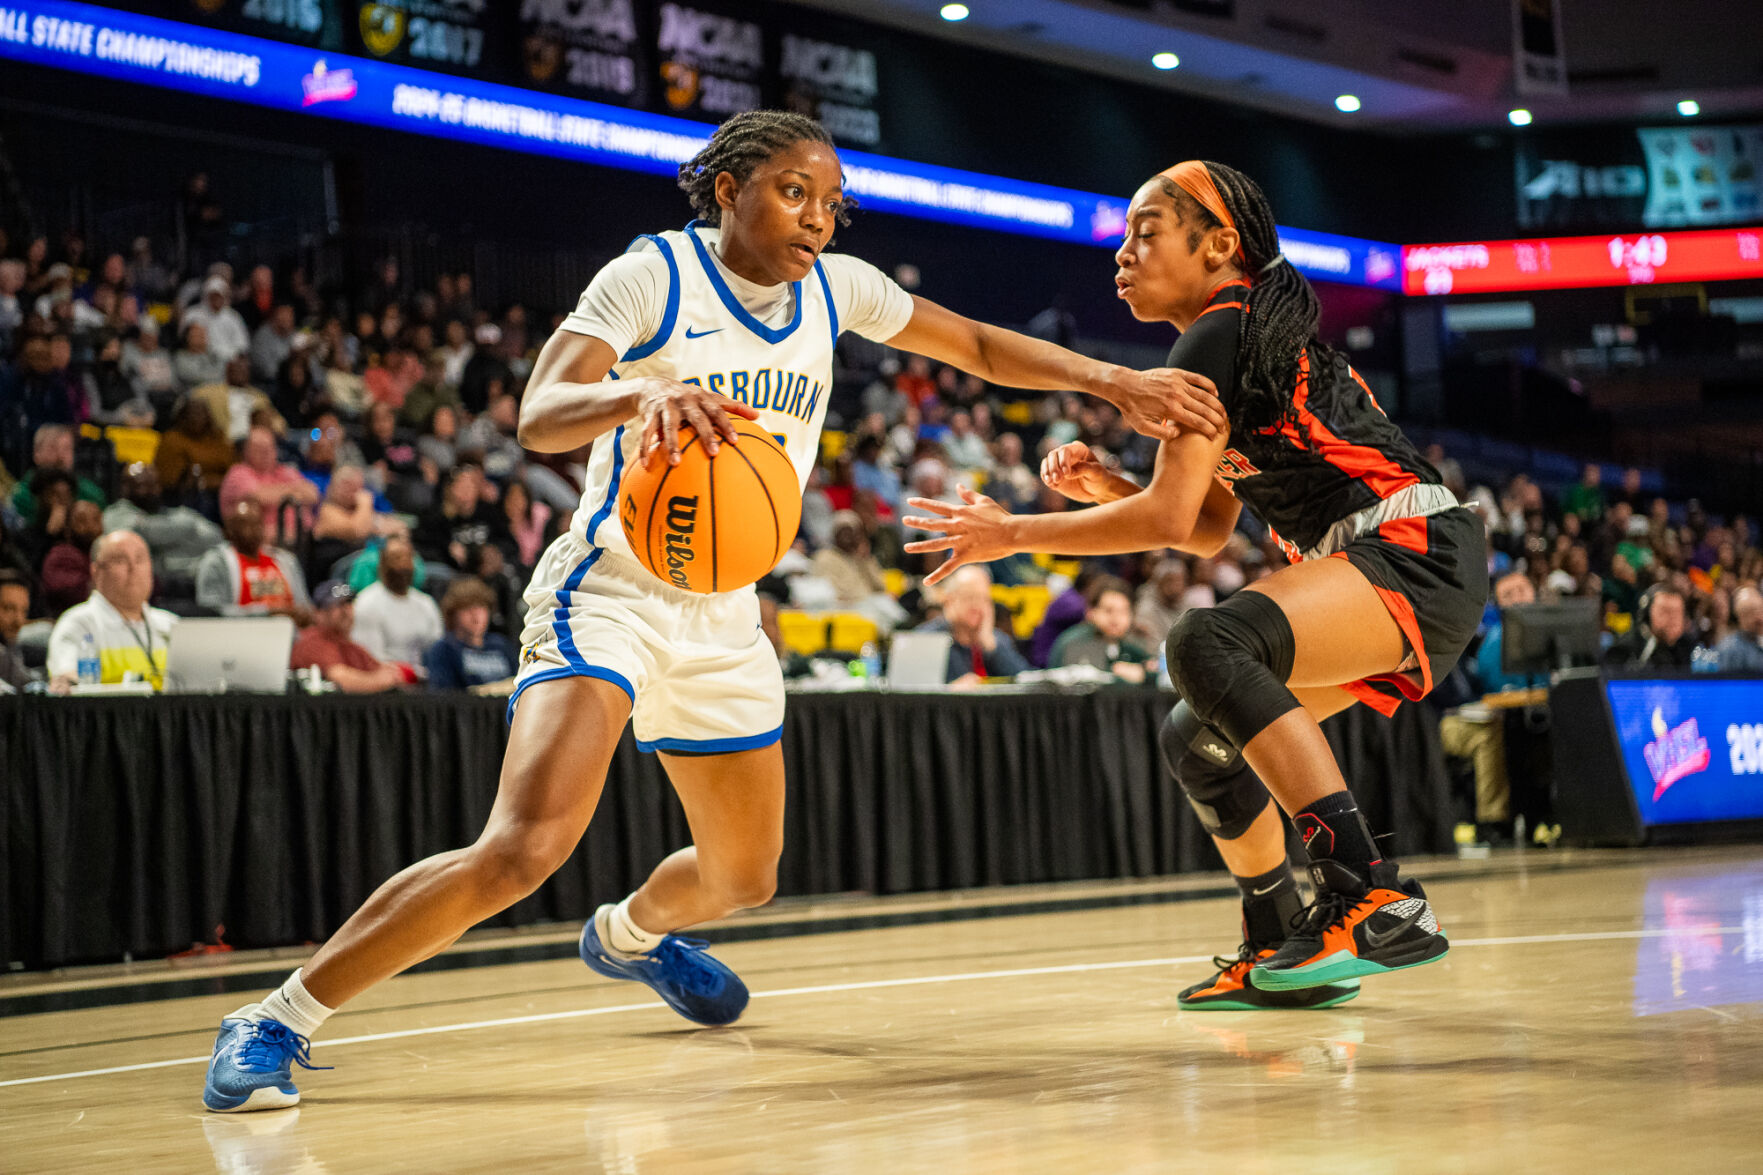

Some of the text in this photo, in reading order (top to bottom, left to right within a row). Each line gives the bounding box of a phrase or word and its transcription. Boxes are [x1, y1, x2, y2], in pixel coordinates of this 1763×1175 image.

[32, 15, 95, 56] STATE
[96, 27, 261, 87] CHAMPIONSHIPS
[665, 495, 699, 591] Wilson
